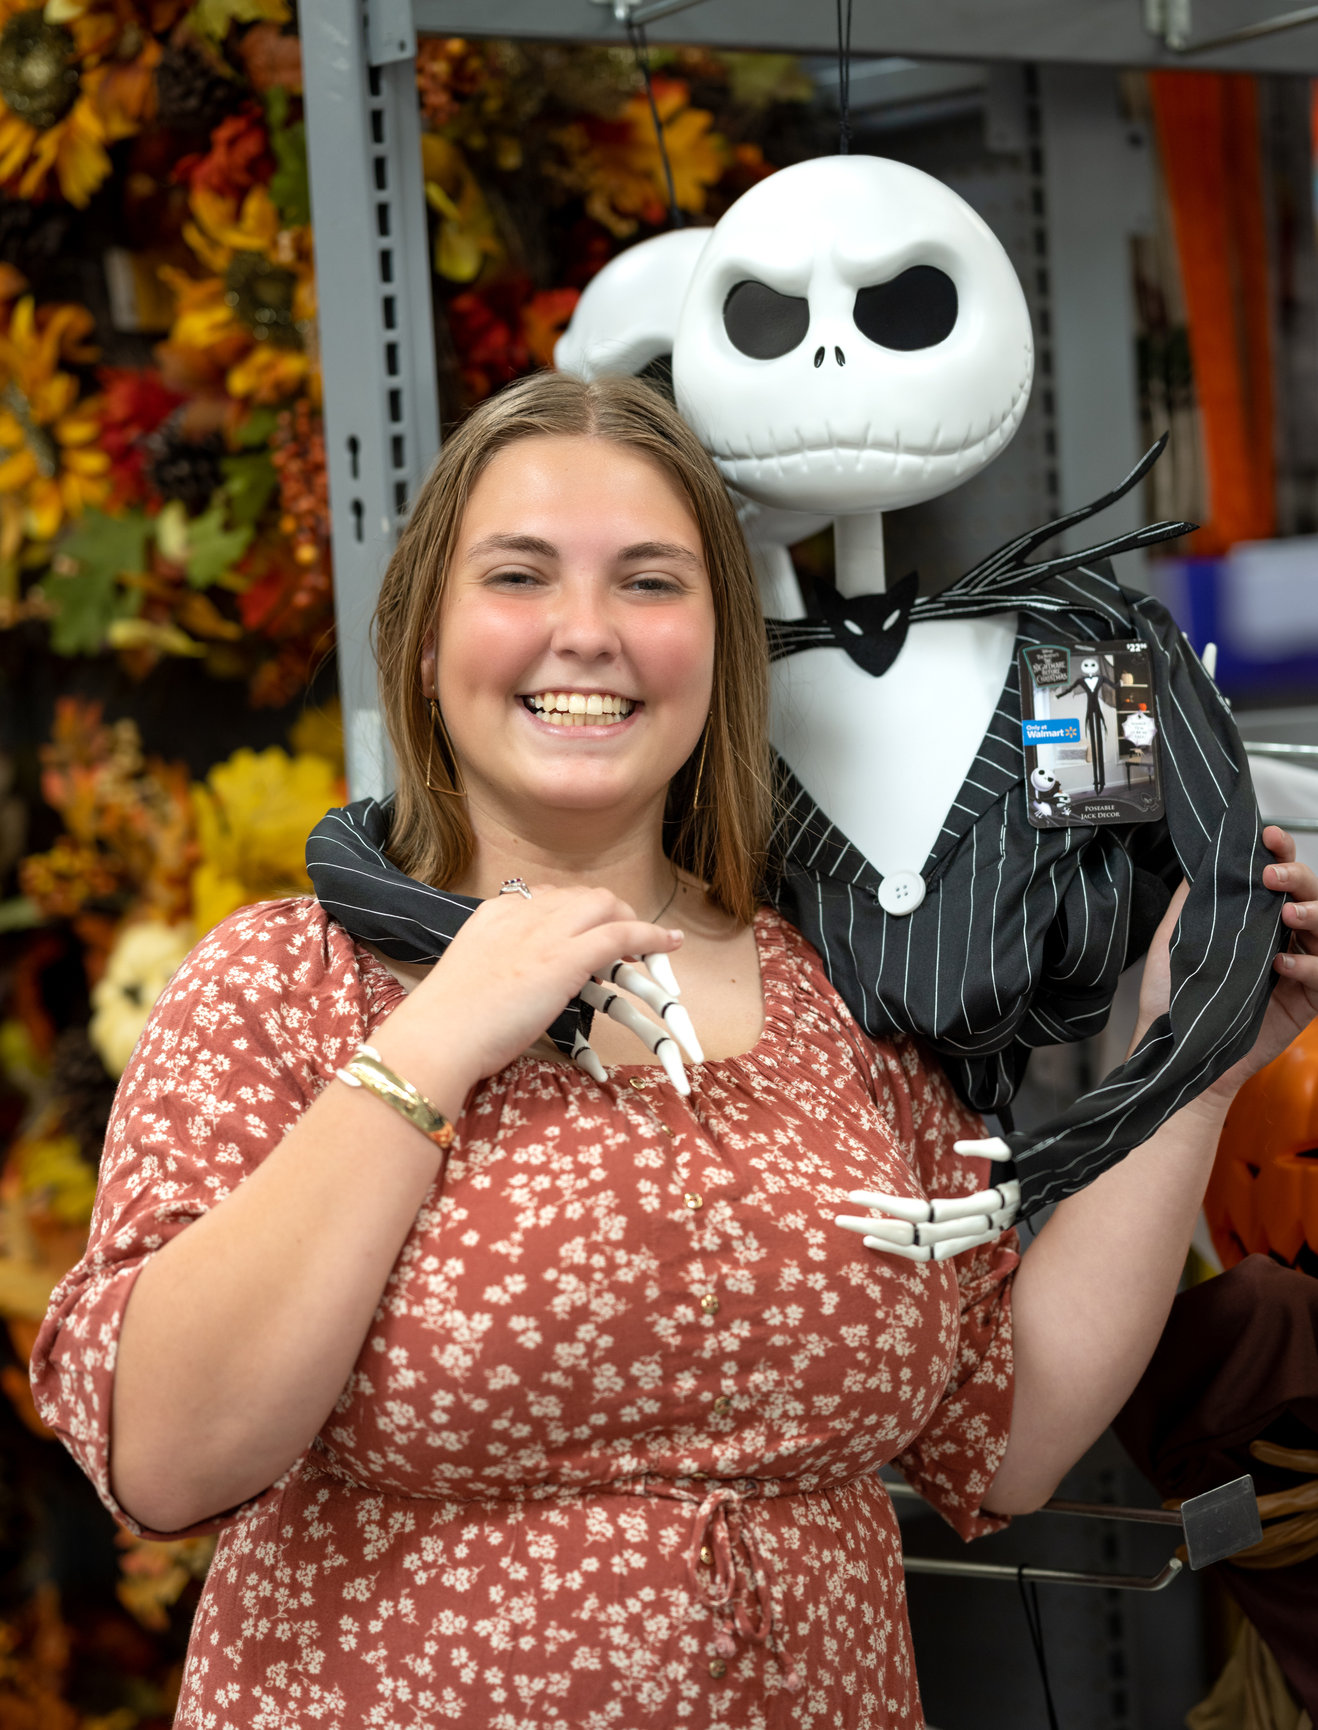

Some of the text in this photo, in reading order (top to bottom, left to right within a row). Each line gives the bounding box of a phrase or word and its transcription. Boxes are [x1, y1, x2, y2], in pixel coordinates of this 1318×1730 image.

[1027, 729, 1064, 738] Walmart
[1085, 804, 1115, 812] POSEABLE
[1097, 811, 1120, 819] DECOR
